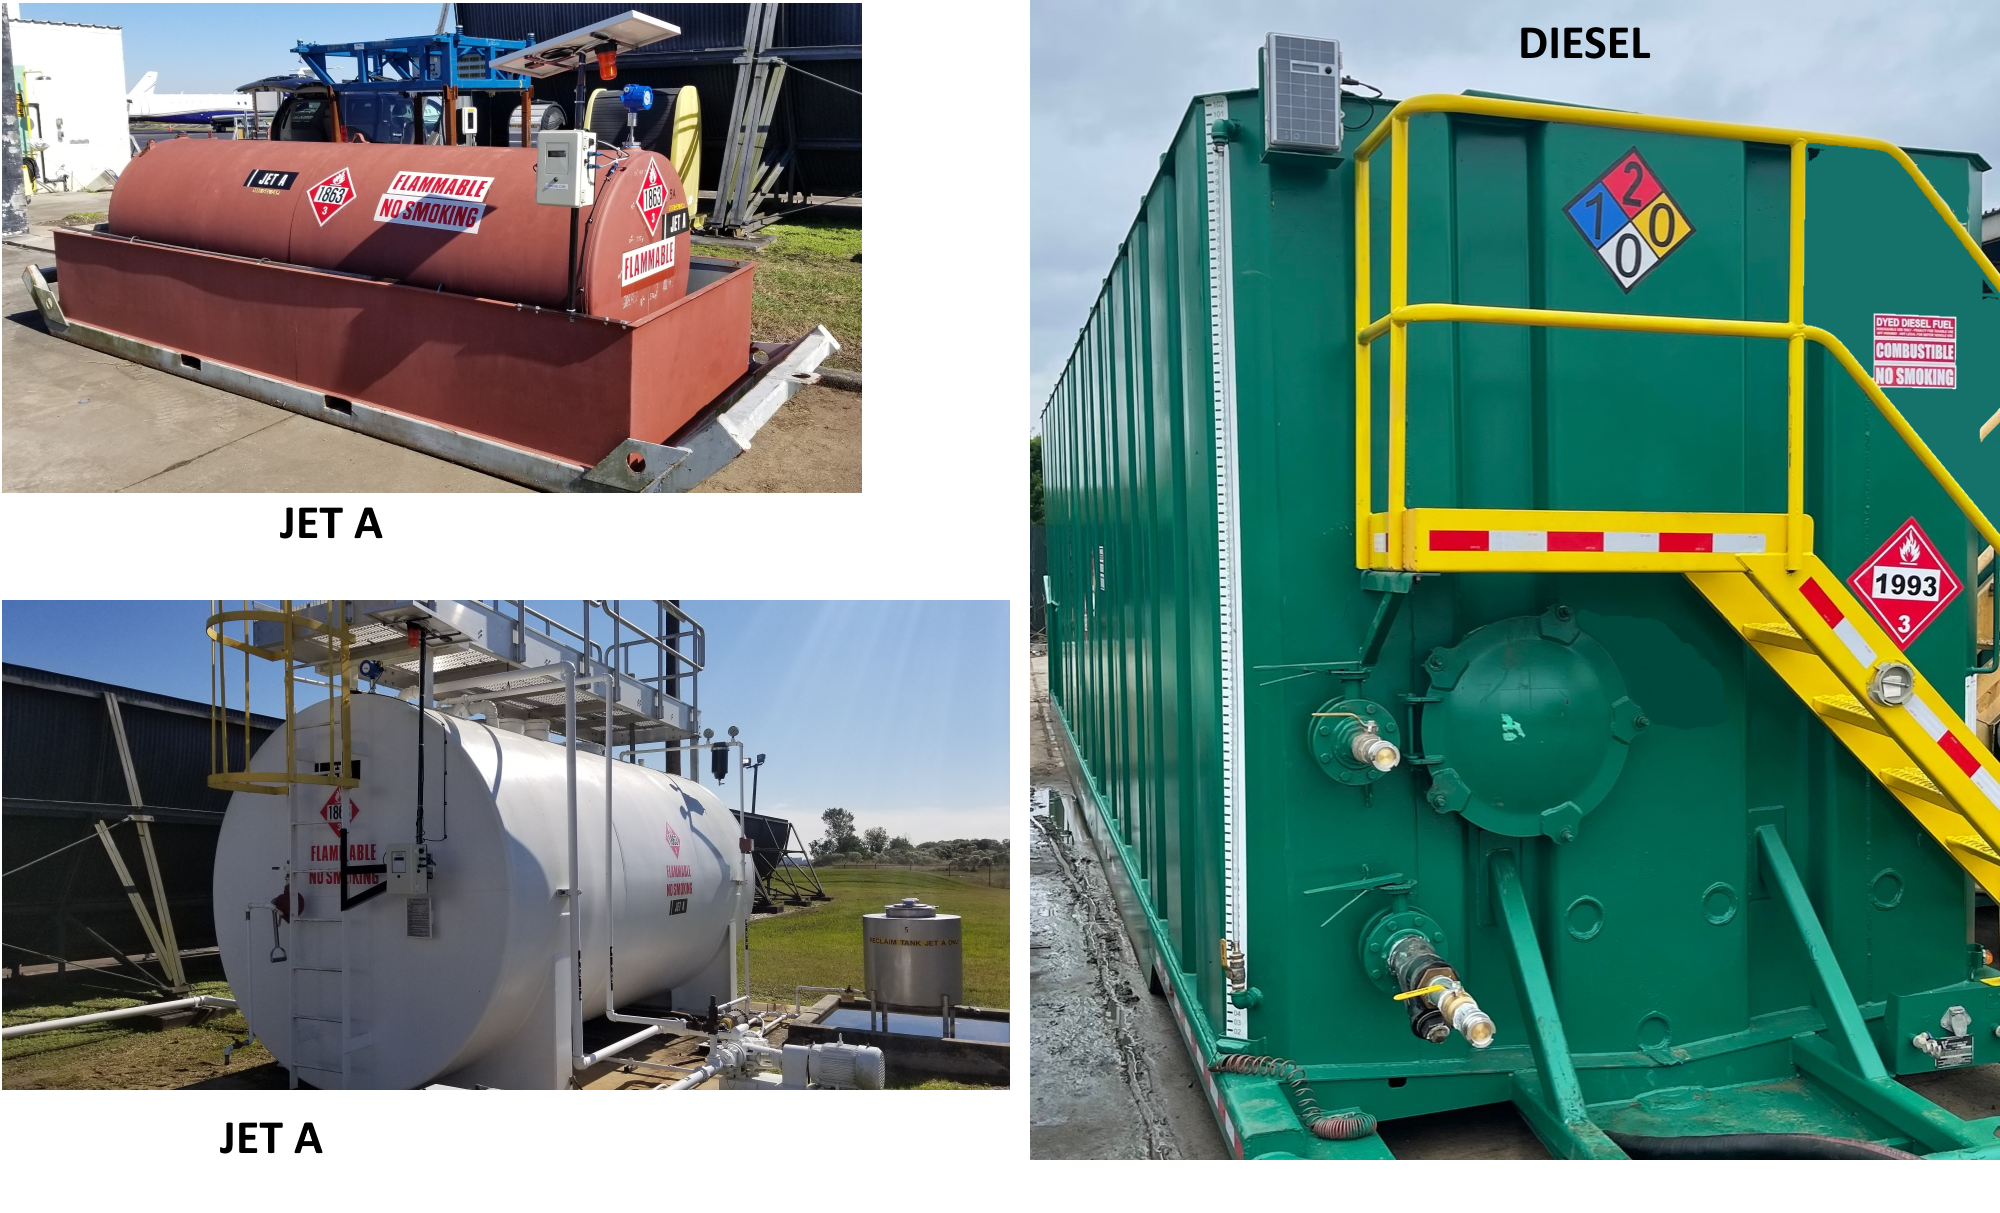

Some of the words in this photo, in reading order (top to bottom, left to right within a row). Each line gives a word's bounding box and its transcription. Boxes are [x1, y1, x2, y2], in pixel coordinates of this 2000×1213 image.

[259, 173, 279, 185] JET
[278, 174, 289, 186] A
[393, 174, 488, 197] FLAMMABLE
[1622, 161, 1644, 207] 2
[317, 186, 345, 203] 1863
[644, 186, 662, 209] 1863
[322, 206, 328, 215] 3
[379, 199, 403, 218] NO
[402, 201, 478, 228] SMOKING
[651, 213, 655, 223] 3
[1585, 192, 1603, 240] 1
[670, 214, 681, 233] JET
[682, 212, 686, 229] A
[1649, 203, 1675, 248] 0
[624, 242, 673, 280] FLAMMABLE
[1615, 233, 1642, 278] 0
[1876, 317, 1900, 327] DYED
[1901, 318, 1931, 328] DIESEL
[1932, 320, 1954, 329] FUEL
[1876, 342, 1954, 360] COMBUSTIBLE
[1875, 367, 1893, 385] NO
[1896, 367, 1954, 386] SMOKING
[1876, 573, 1937, 597] 1993
[1897, 615, 1911, 633] 3
[311, 844, 377, 861] FLAMABLE
[326, 870, 379, 884] SMKING
[666, 884, 674, 896] NO
[674, 883, 693, 896] SMOKING
